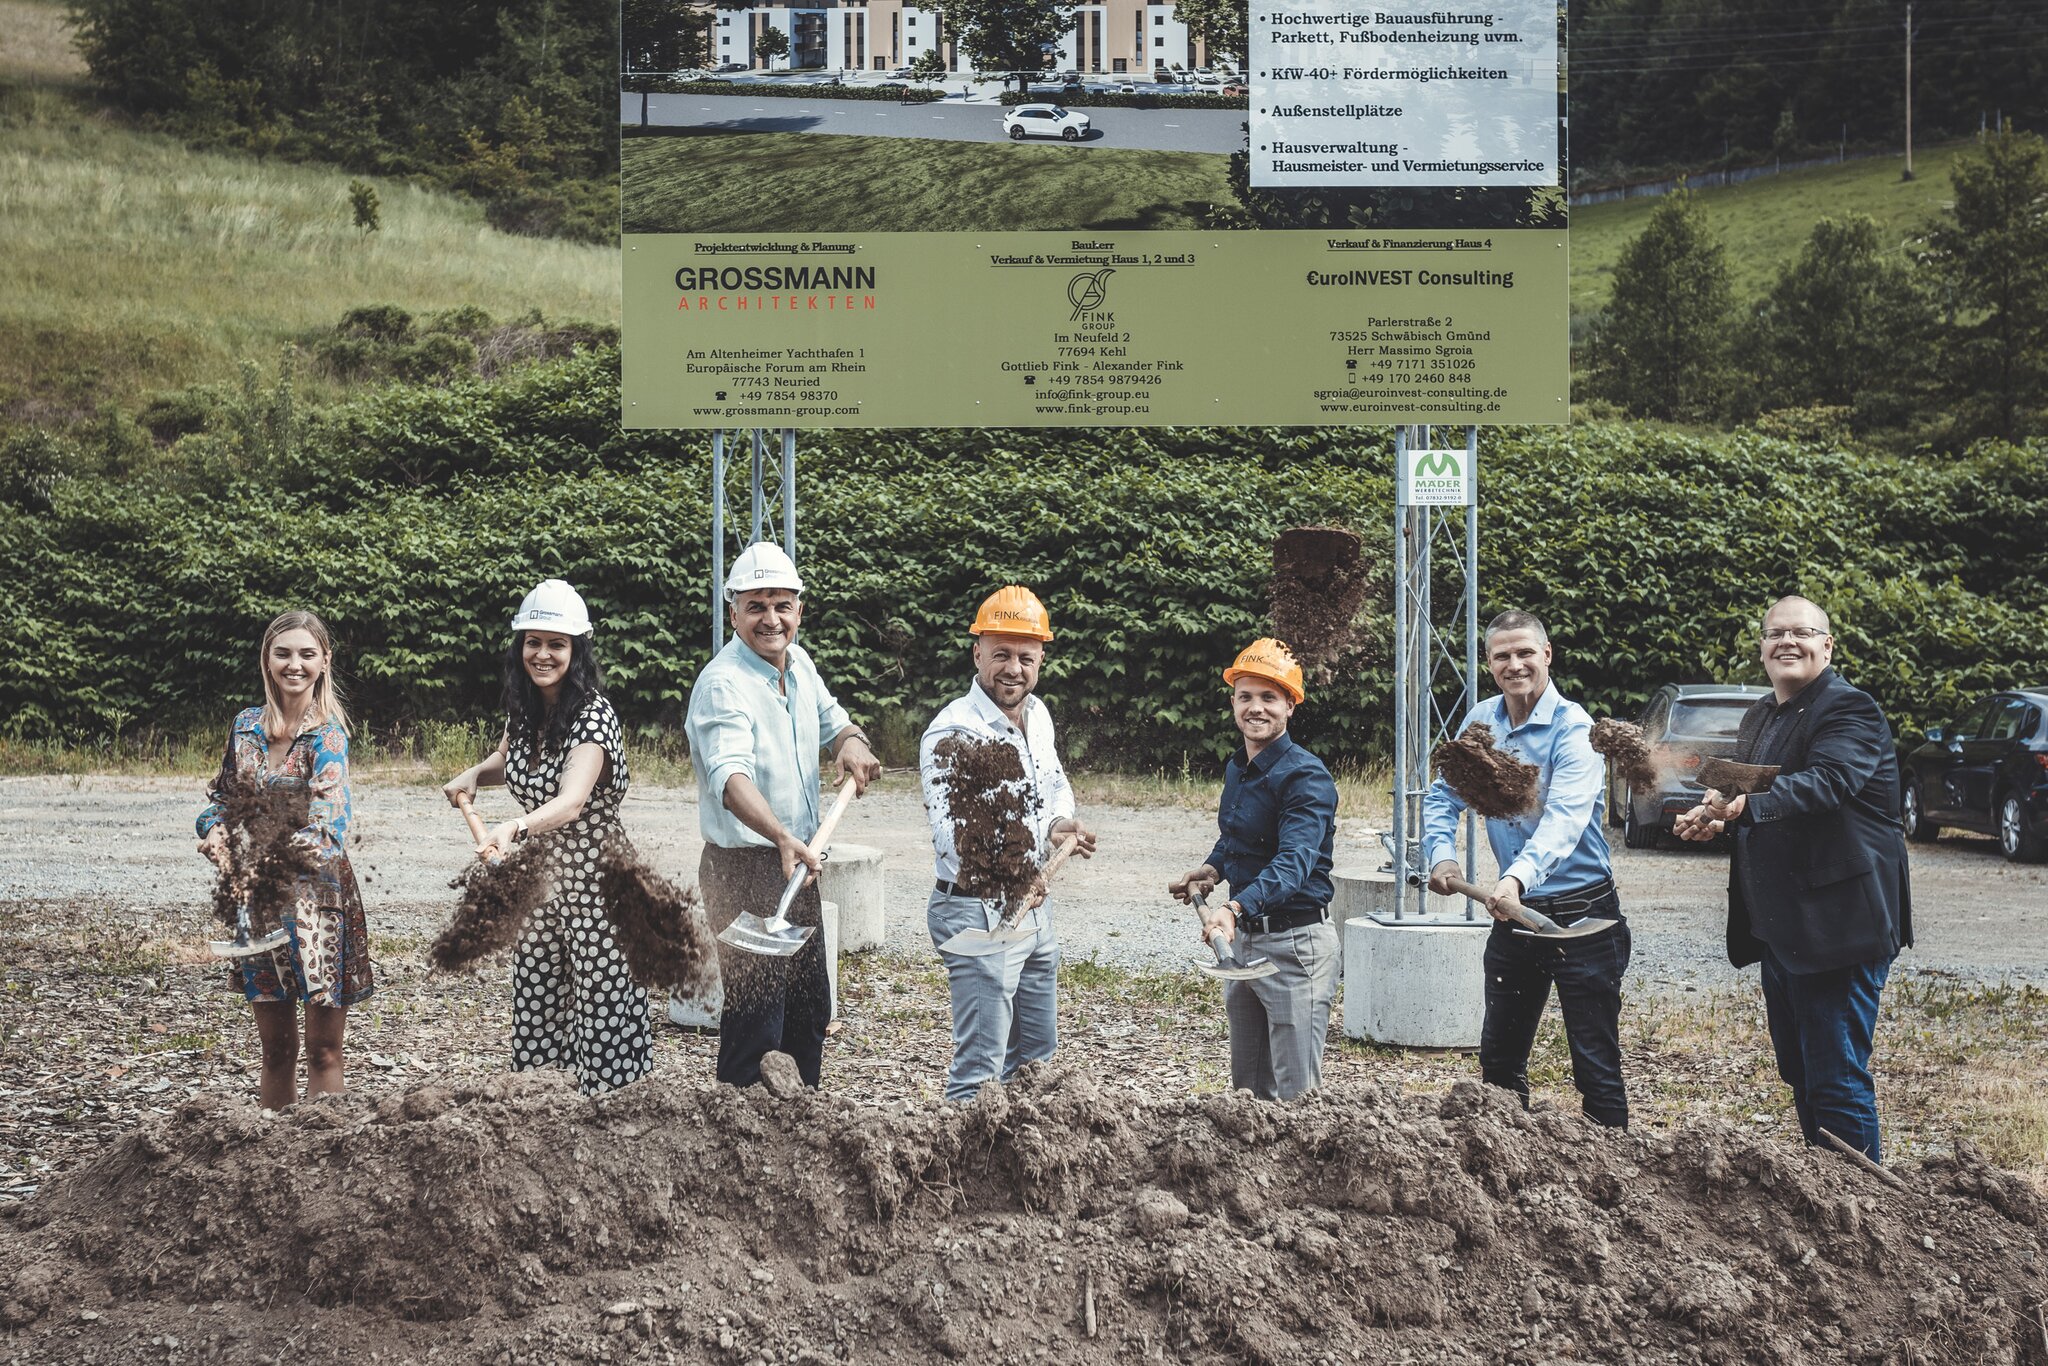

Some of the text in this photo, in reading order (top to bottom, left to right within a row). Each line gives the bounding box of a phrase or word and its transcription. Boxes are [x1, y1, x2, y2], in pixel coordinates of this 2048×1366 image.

[1271, 12, 1370, 26] Hochwertige
[1374, 12, 1494, 27] Bauausführung
[1271, 31, 1523, 45] Parkett, Fußbodenheizung uvm.
[1271, 66, 1508, 81] KfW-40+ Fördermöglichkeiten
[1271, 105, 1403, 119] Außenstellplätze
[1272, 141, 1398, 155] Hausverwaltung
[1272, 159, 1545, 174] Hausmeister- und Vermietungsservice
[694, 242, 856, 254] Projektentwicklung & Planung
[1327, 239, 1493, 250] Verkauf & Finanzierung Haus 4
[991, 254, 1196, 266] Verkauf & Vermietung Haus 1, 2 und 3
[674, 267, 876, 291] GROSSMANN
[1306, 270, 1514, 288] €uroINVEST Consulting
[678, 295, 875, 311] ARCHITEKTEN
[1082, 312, 1115, 322] FINK
[1367, 316, 1453, 327] Parlerstraße 2
[1082, 323, 1115, 331] GROUP
[1054, 333, 1131, 343] Im Neufeld 2
[1330, 330, 1491, 341] 73525 Schwäbisch Gmünd
[686, 348, 865, 360] Am Altenheimer Yachthafen 1
[1057, 346, 1127, 357] 77694 Kehl
[1348, 345, 1473, 357] Herr Massimo Sgroia
[686, 362, 867, 375] Europäische Forum am Rhein
[1001, 361, 1049, 371] Gottlieb
[1053, 361, 1081, 371] Fink
[1092, 361, 1153, 371] Alexander
[1156, 361, 1184, 371] Fink
[1370, 359, 1476, 370] +49 7171 351026
[731, 376, 821, 387] 77743 Neuried
[1048, 375, 1162, 385] +49 7854 9879426
[1362, 373, 1472, 384] +49 170 2460 848
[739, 391, 838, 401] +49 7854 98370
[1035, 389, 1150, 402] info@fink-group.eu
[1313, 387, 1508, 401] sgroia@euroinvest-consulting.de
[692, 405, 860, 418] www.grossmann-group.com
[1035, 404, 1150, 416] www.fink-group.eu
[1320, 402, 1501, 415] www.euroinvest-consulting.de
[1415, 480, 1461, 488] MÄDER
[994, 611, 1020, 620] FINK
[1240, 655, 1264, 664] FINK
